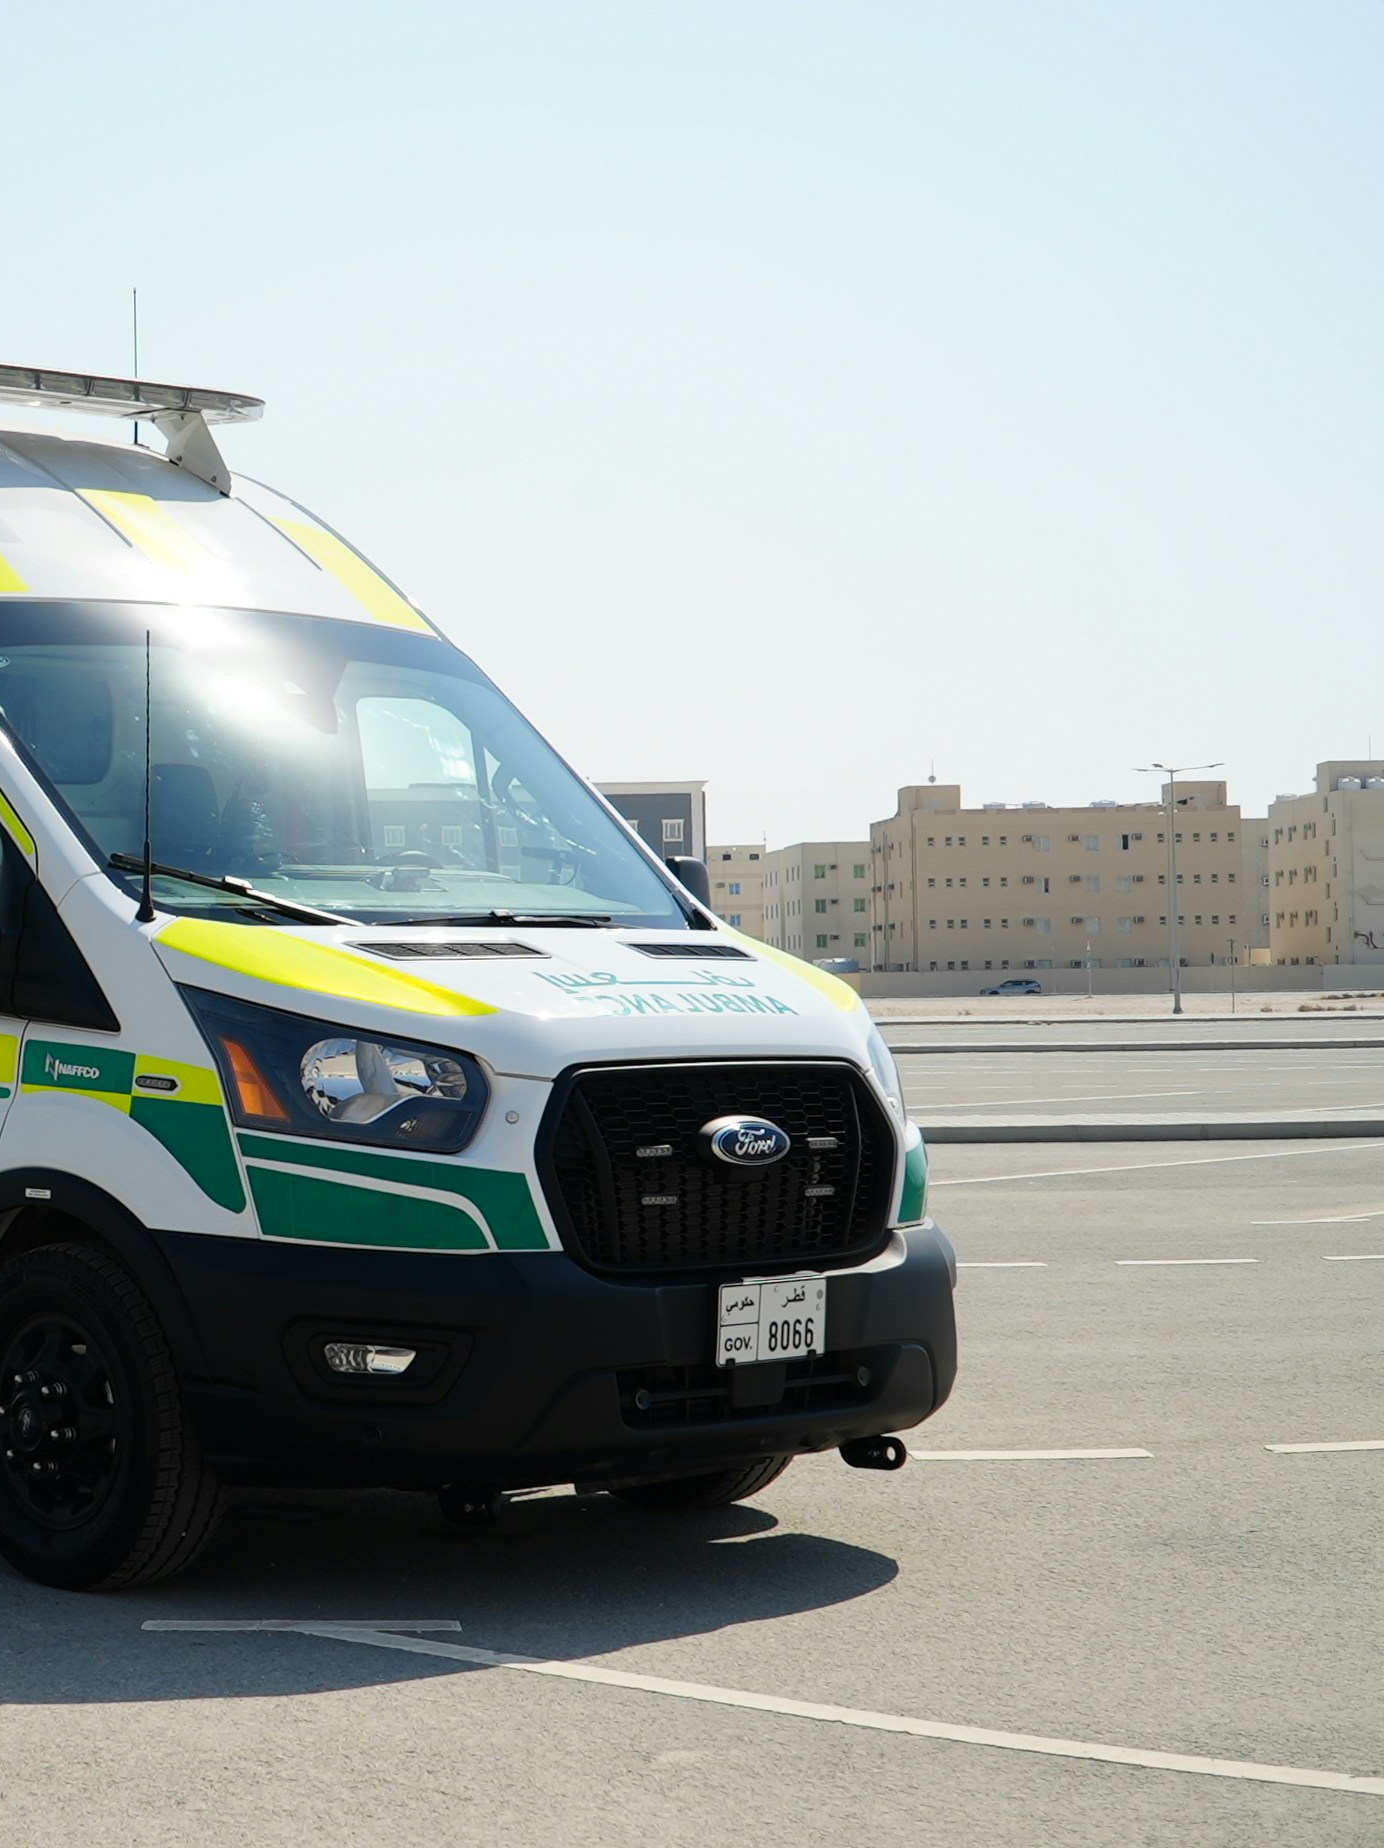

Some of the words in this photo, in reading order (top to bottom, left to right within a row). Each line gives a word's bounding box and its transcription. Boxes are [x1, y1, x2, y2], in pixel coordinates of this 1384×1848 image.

[59, 1061, 100, 1079] NAFFCO
[735, 1128, 777, 1156] Ford
[725, 1296, 755, 1316] حكومي
[781, 1285, 806, 1308] قطر
[724, 1336, 753, 1351] GOV.
[768, 1317, 815, 1351] 8066
